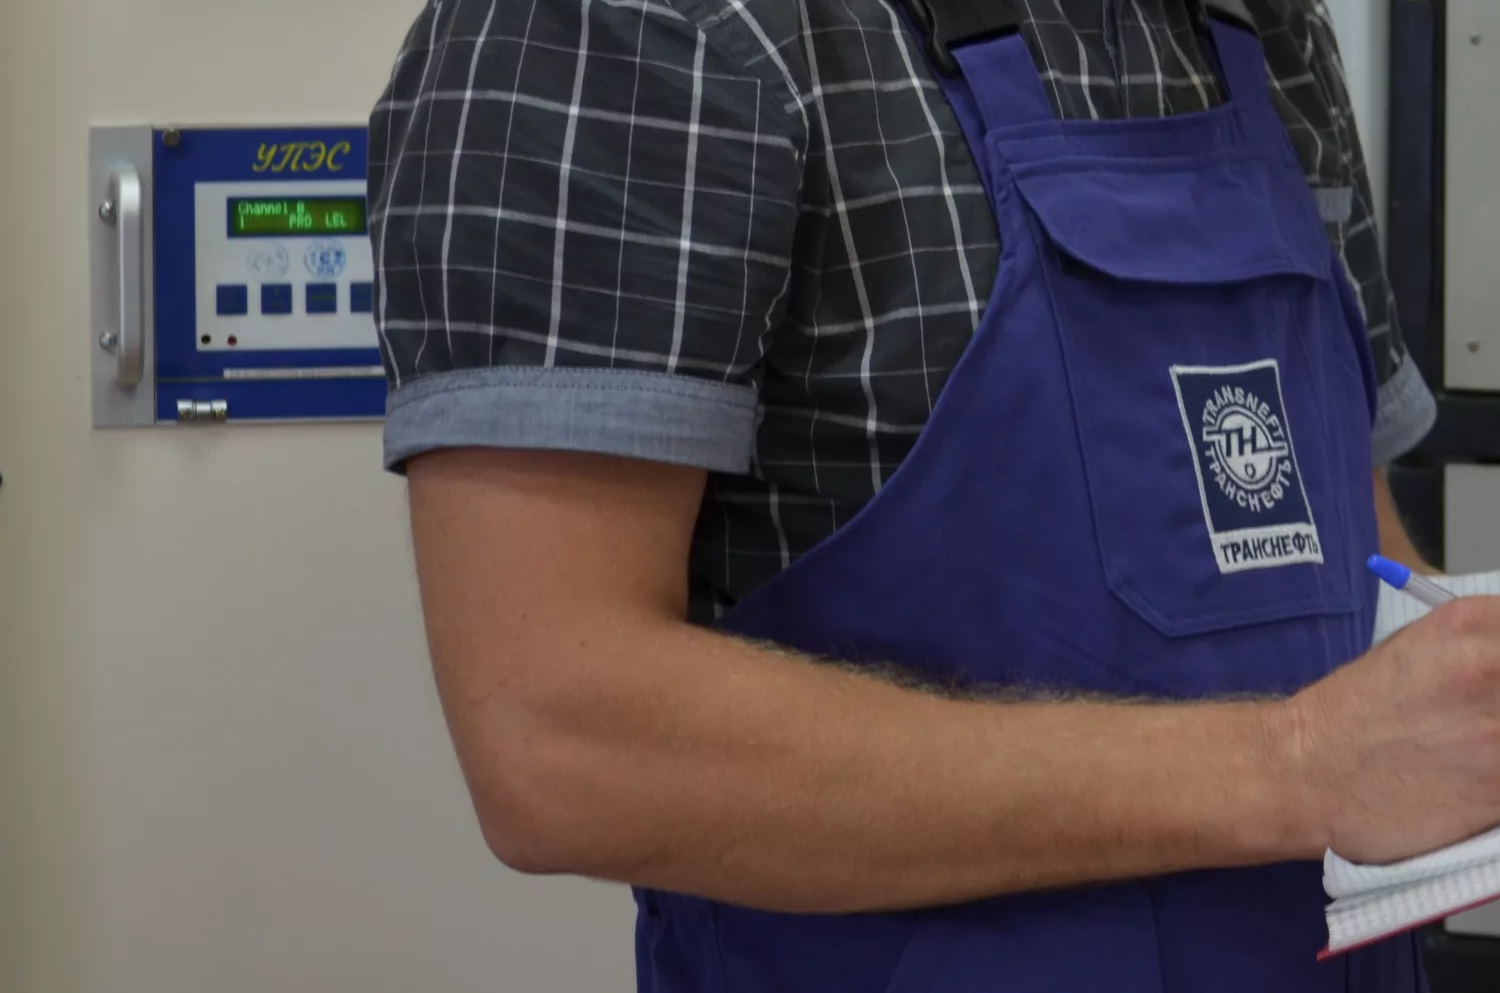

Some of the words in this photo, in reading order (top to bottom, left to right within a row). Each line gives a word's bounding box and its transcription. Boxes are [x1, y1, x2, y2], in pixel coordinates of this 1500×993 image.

[252, 141, 350, 173] УПЭС
[238, 201, 288, 216] Channel
[325, 212, 347, 228] LEL
[1203, 385, 1283, 445] TRANSNEFT
[1205, 446, 1292, 513] ТРАНСНЕФТЬ
[1220, 532, 1319, 565] ТРАНСНЕФТЬ
